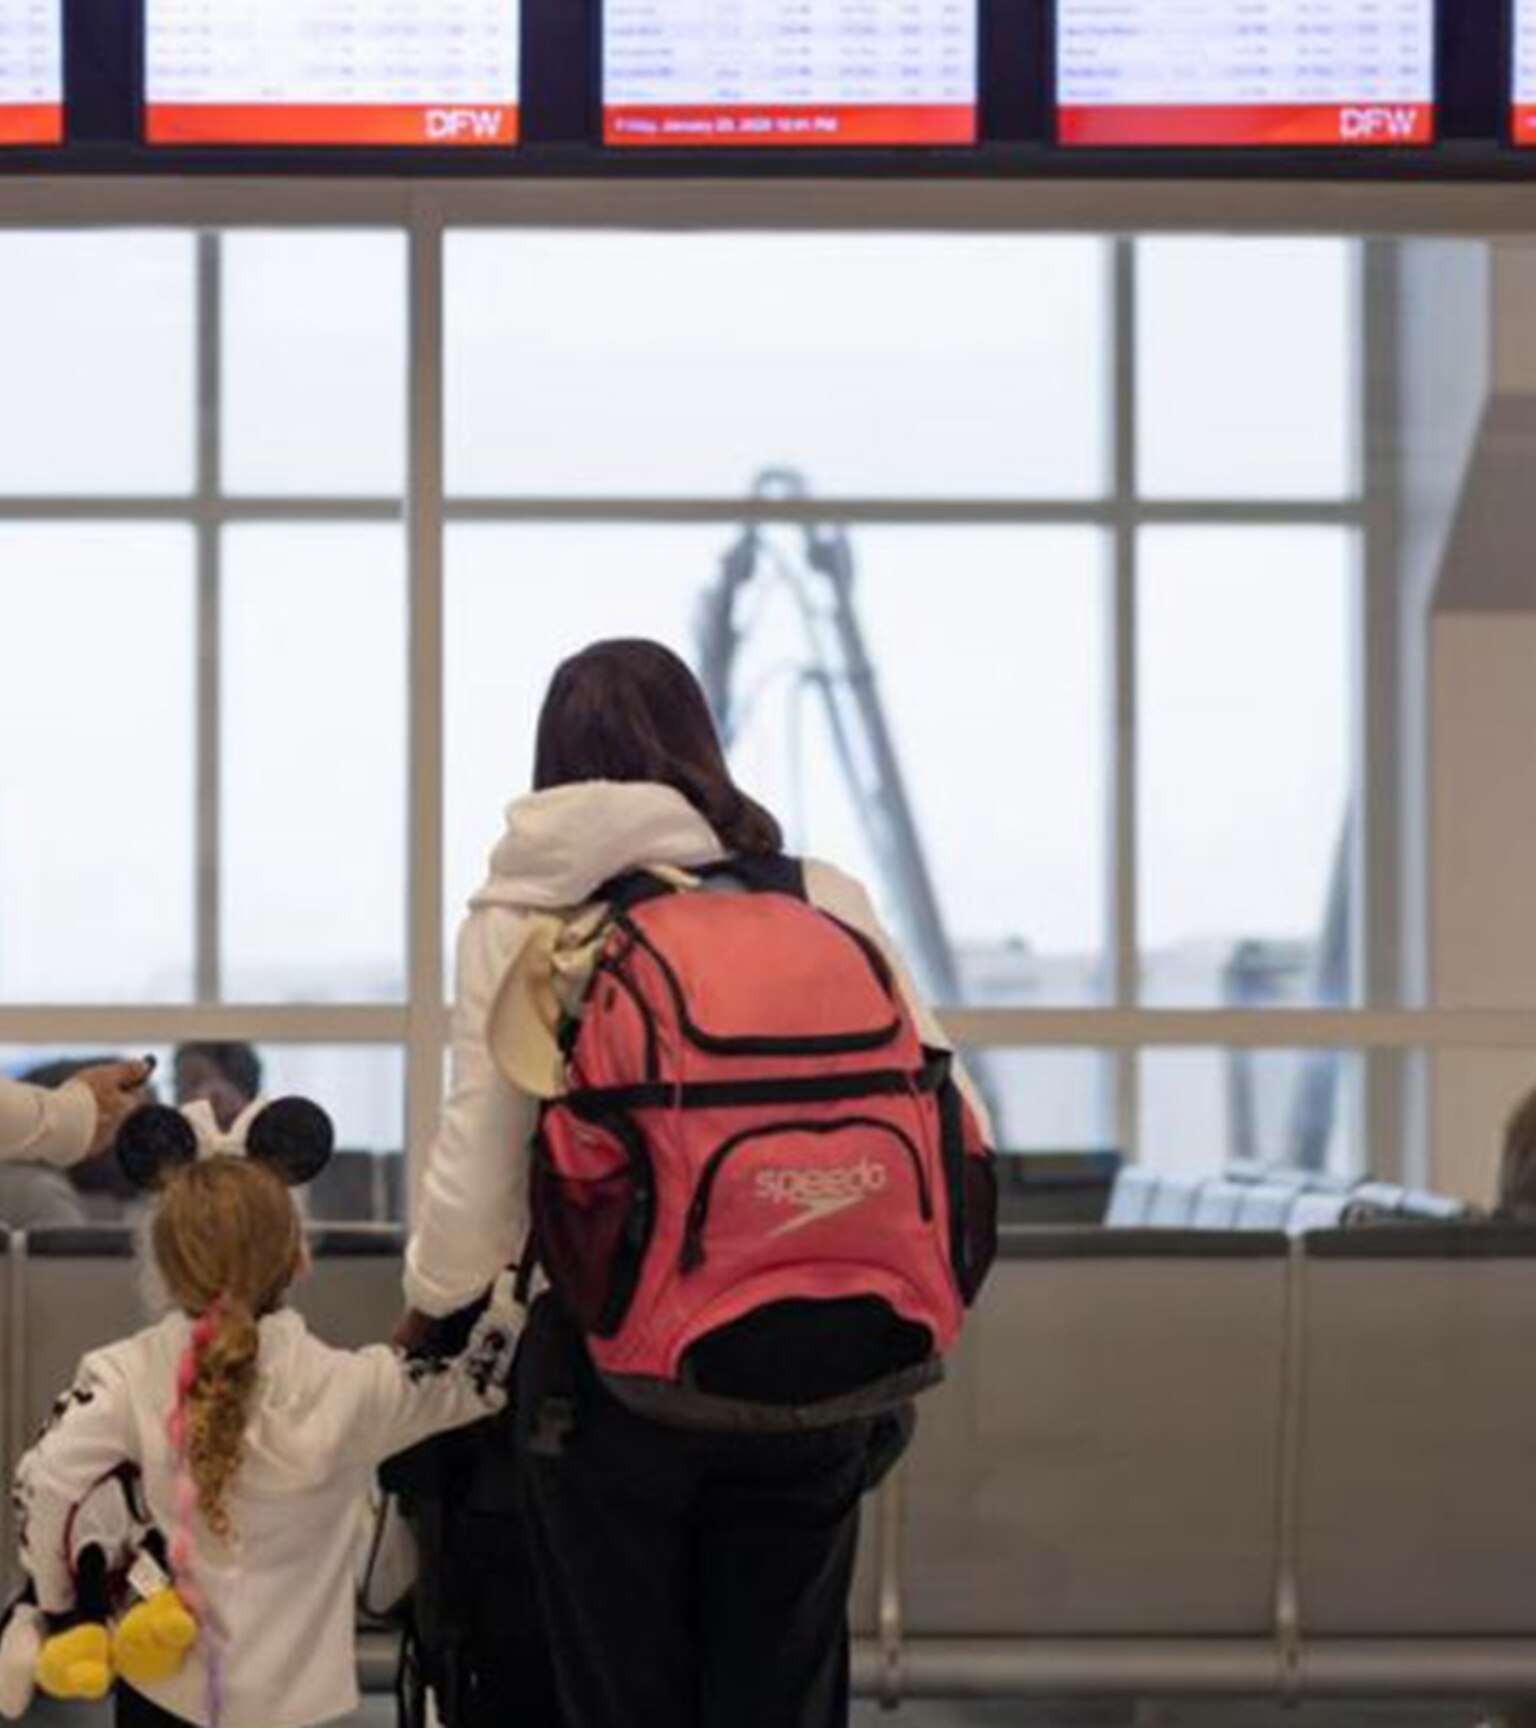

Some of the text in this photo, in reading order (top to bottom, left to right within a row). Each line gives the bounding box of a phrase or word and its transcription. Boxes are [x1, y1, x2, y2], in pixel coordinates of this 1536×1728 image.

[426, 109, 501, 138] DFW
[1339, 108, 1416, 136] DFW
[755, 1156, 886, 1204] speedo
